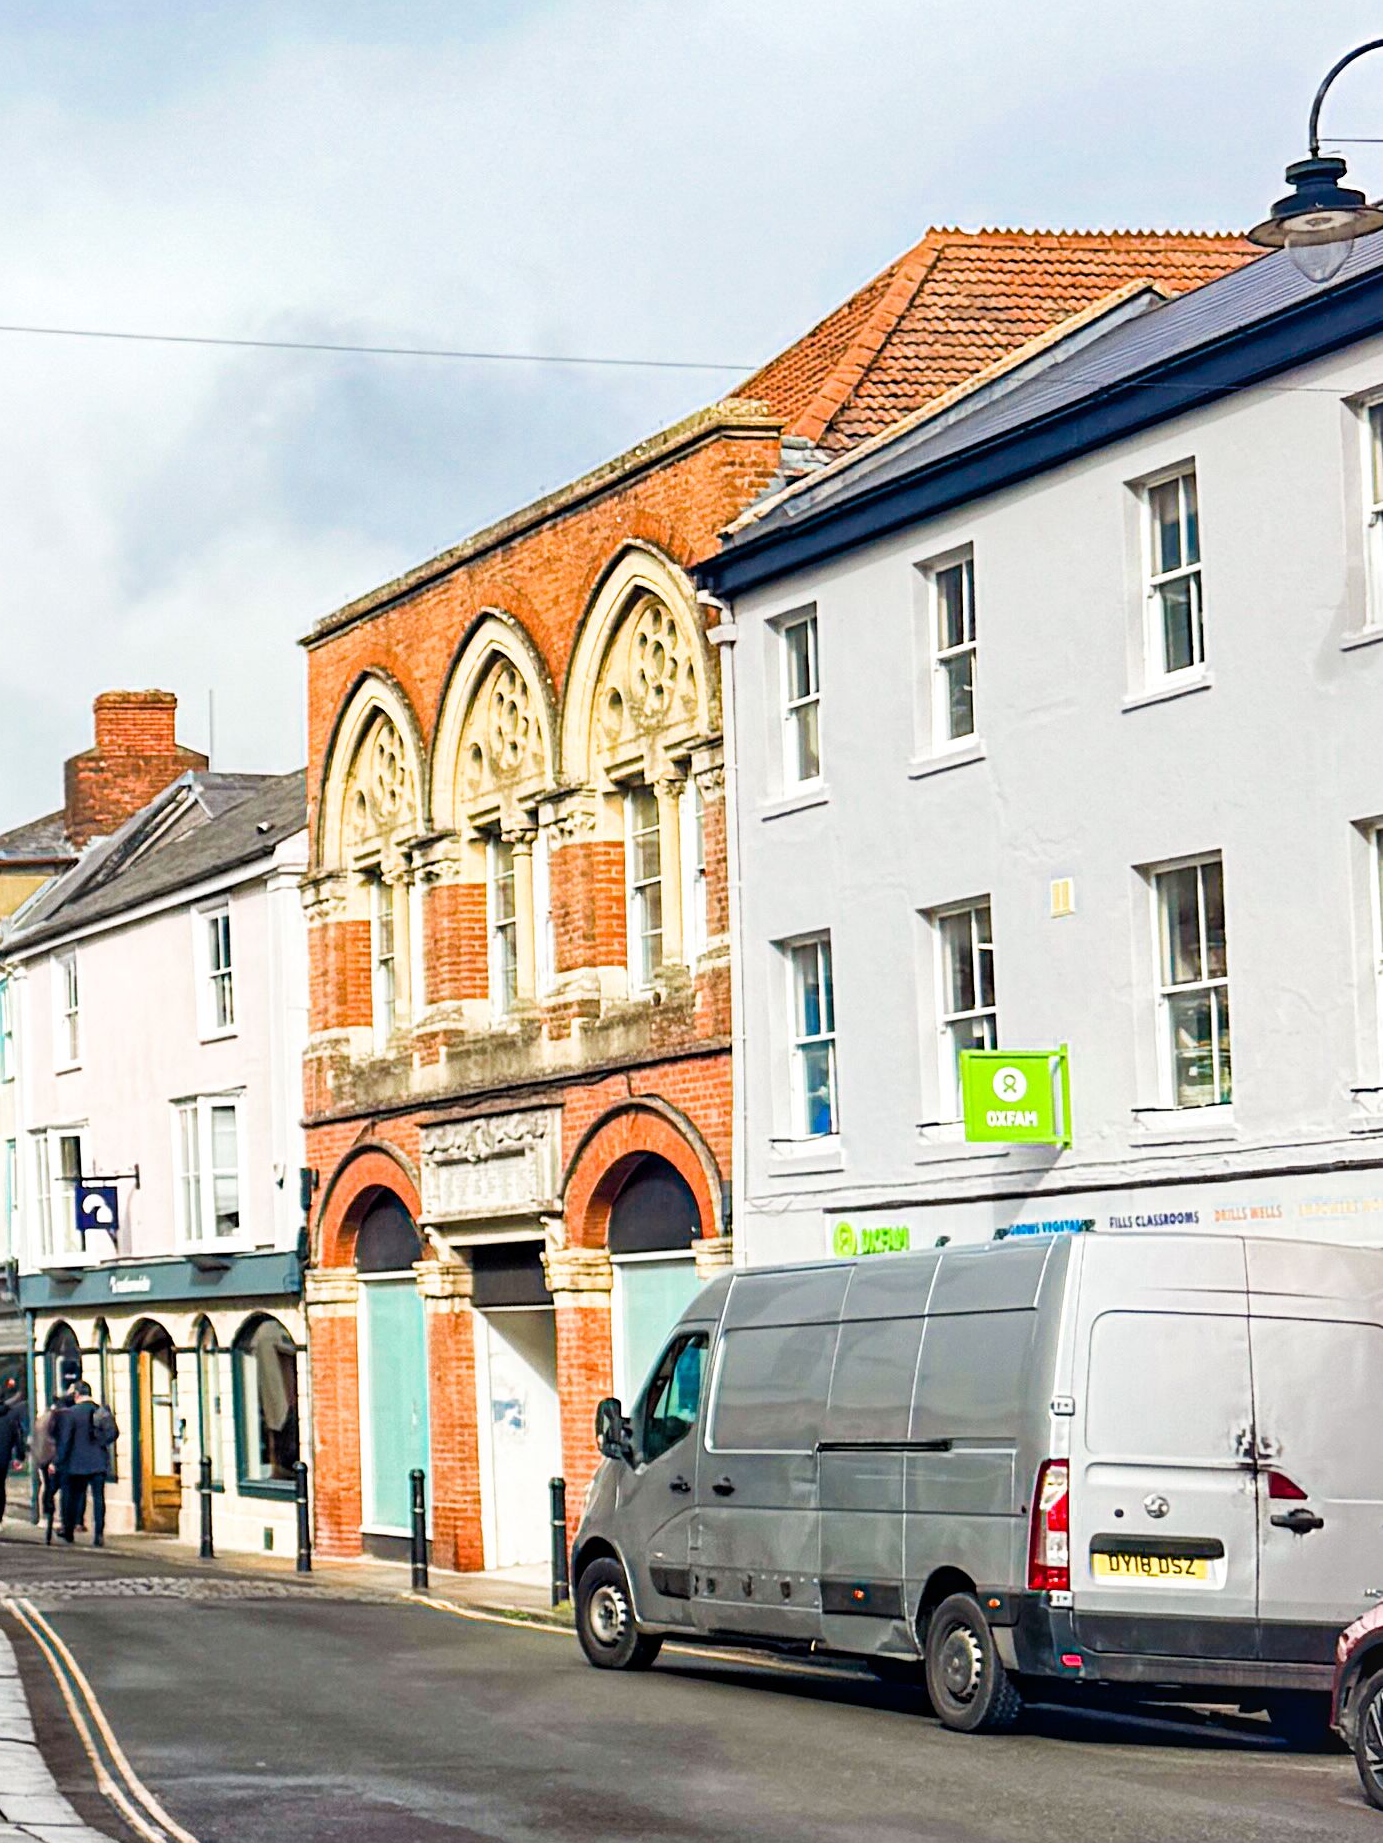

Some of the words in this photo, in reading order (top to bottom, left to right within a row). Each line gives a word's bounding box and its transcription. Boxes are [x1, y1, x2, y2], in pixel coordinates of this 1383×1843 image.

[986, 1110, 1039, 1128] OXFAM
[1109, 1216, 1133, 1229] FILLS
[1135, 1211, 1200, 1228] CLASSROOMS
[1214, 1207, 1247, 1222] DRILLS
